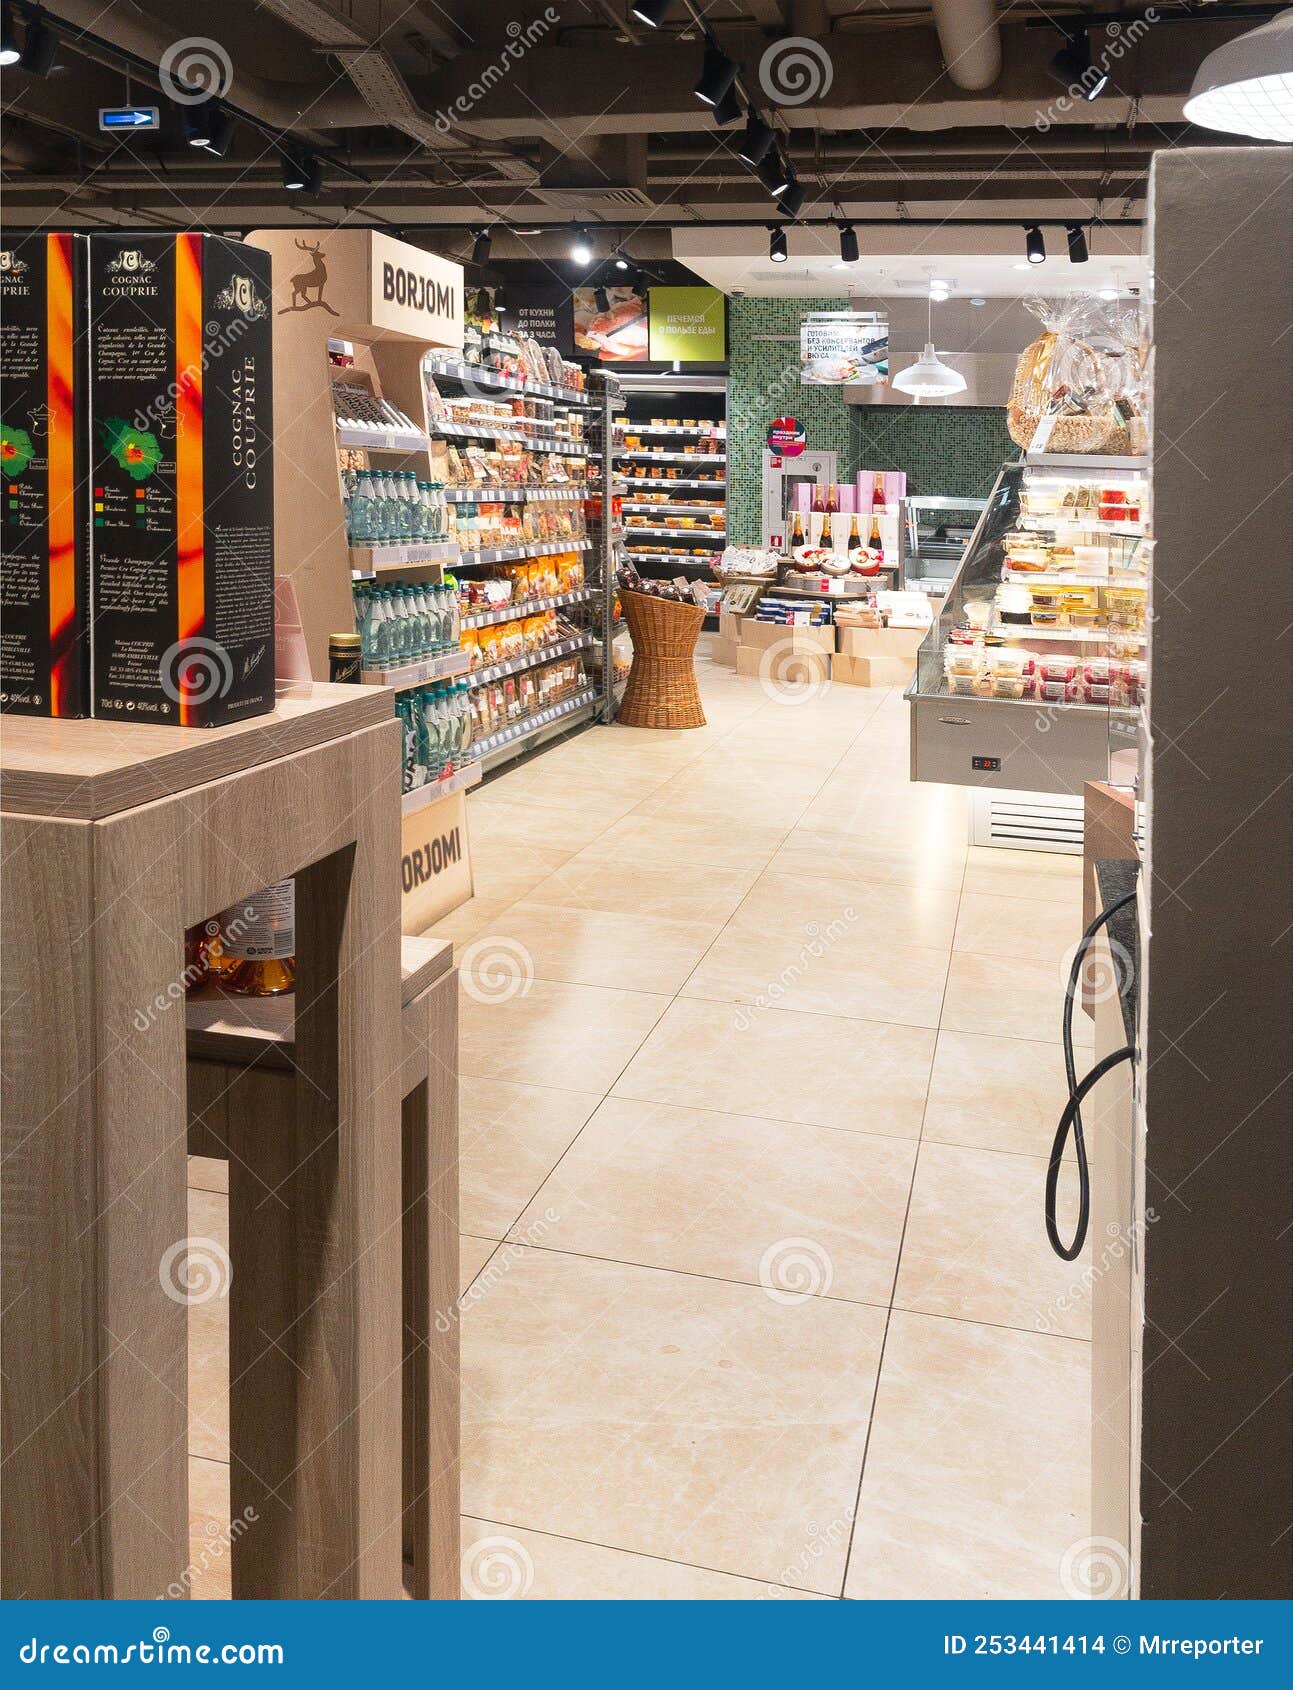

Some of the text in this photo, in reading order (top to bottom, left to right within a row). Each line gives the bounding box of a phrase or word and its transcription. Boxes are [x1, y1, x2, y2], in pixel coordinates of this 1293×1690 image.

[0, 276, 24, 284] GNAC
[111, 275, 152, 284] COGNAC
[2, 286, 31, 296] PRIE
[102, 286, 159, 296] COUPRIE
[383, 261, 455, 320] BORJOMI
[519, 309, 554, 317] ОТ КУХНИ
[517, 320, 556, 329] ДО ПОЛКИ
[535, 331, 557, 339] ЧАСА
[807, 337, 820, 345] БЕЗ
[232, 369, 242, 466] COGNAC
[244, 356, 257, 489] COUPRIE
[401, 826, 462, 894] ORJOMI
